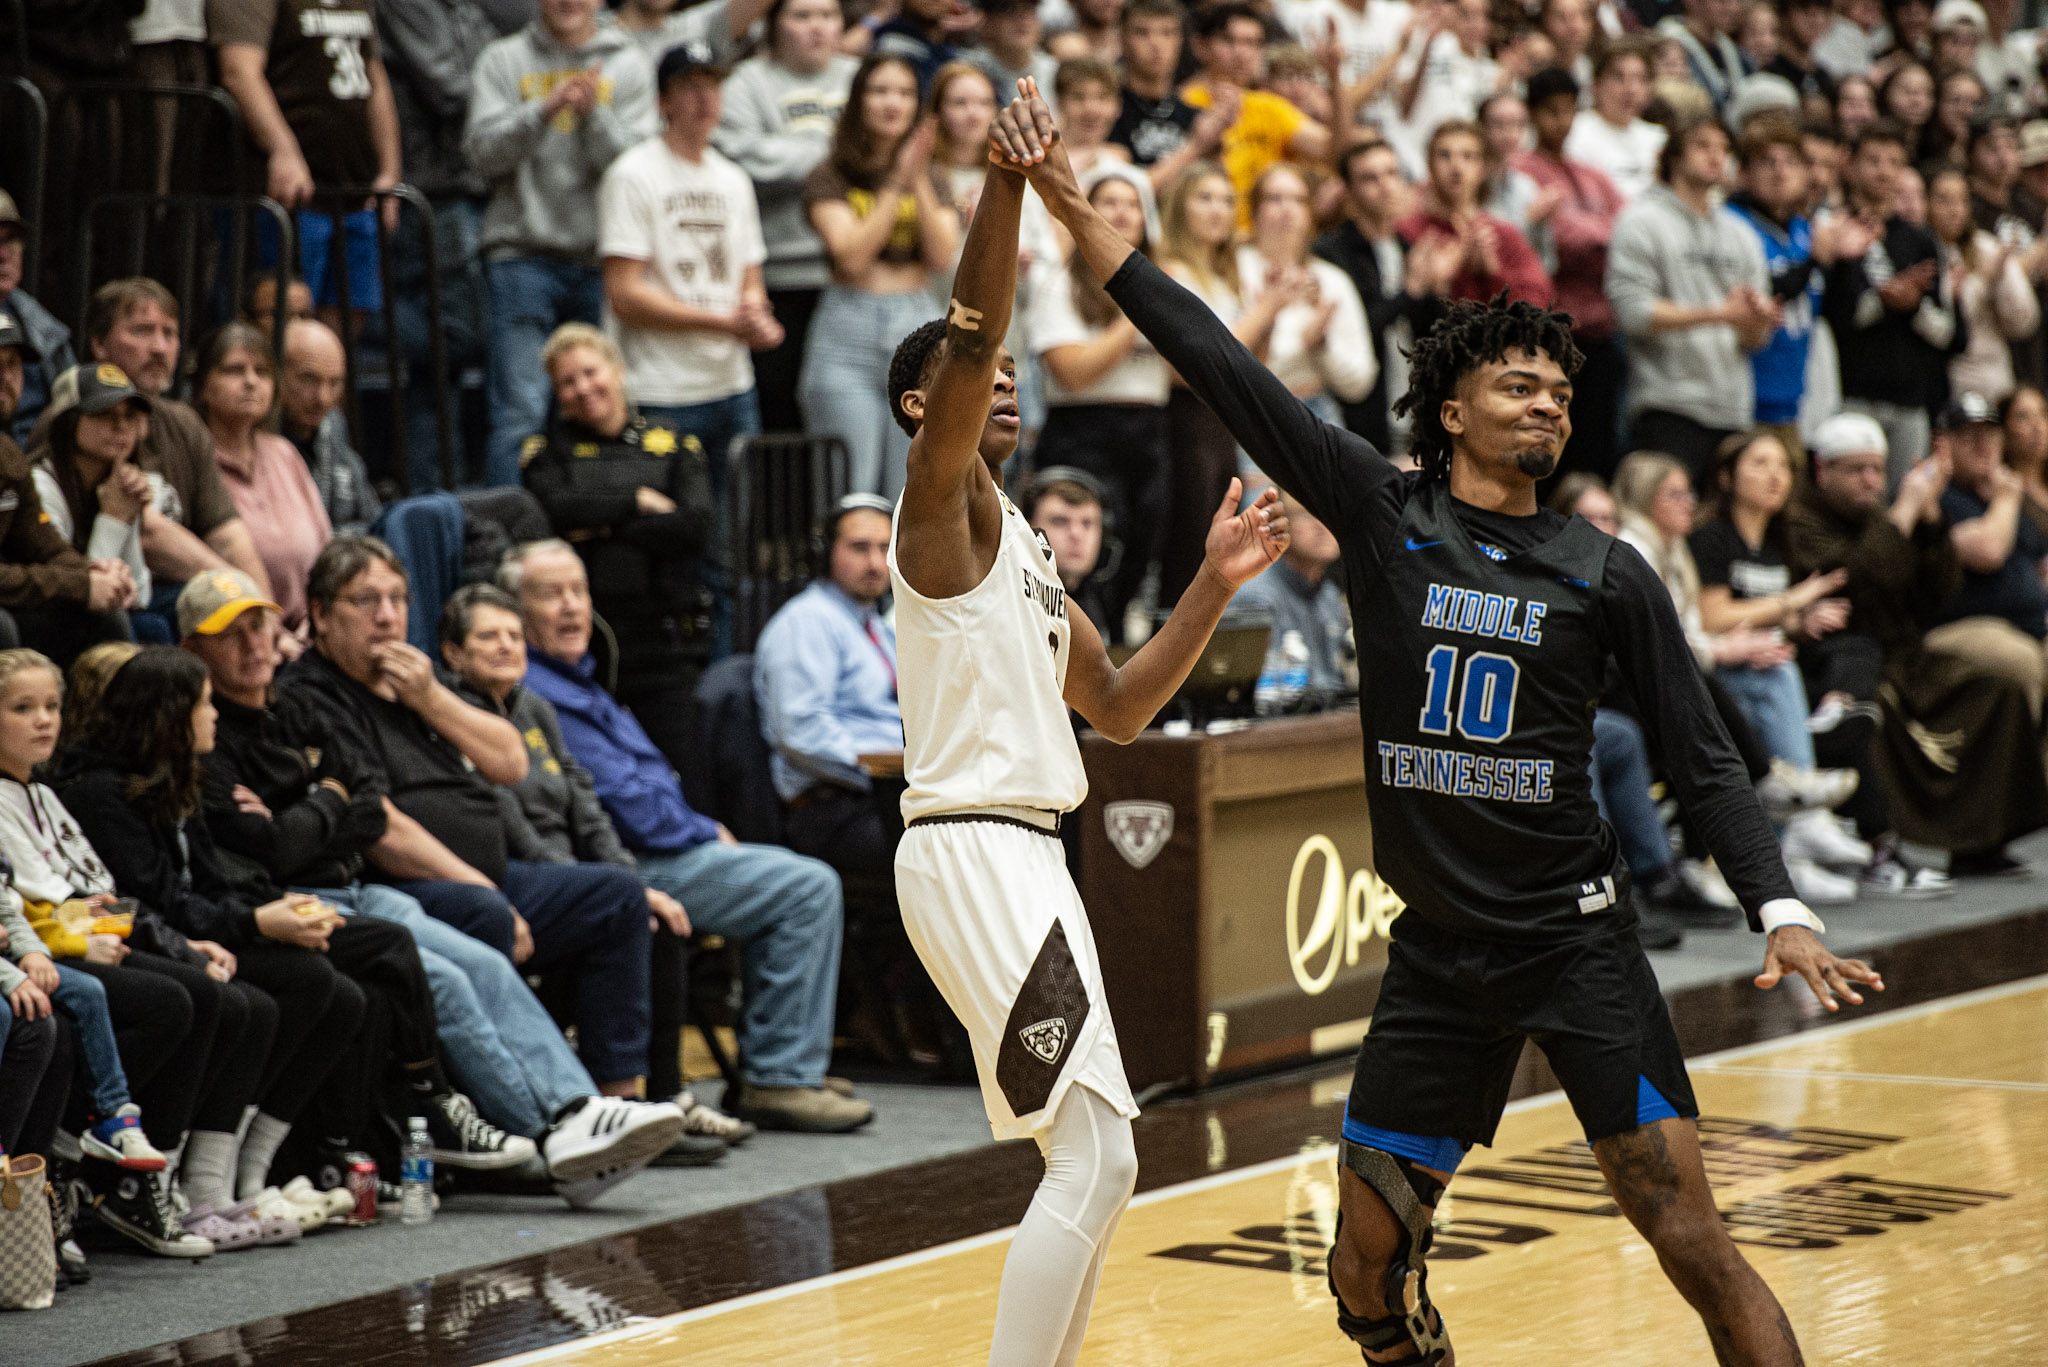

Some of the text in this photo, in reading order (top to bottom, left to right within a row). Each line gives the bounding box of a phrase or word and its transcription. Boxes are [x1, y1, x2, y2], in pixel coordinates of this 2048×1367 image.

[1421, 583, 1547, 646] MIDDLE
[1418, 644, 1520, 744] 10
[1378, 740, 1554, 803] TENNESSEE
[1581, 882, 1597, 895] M
